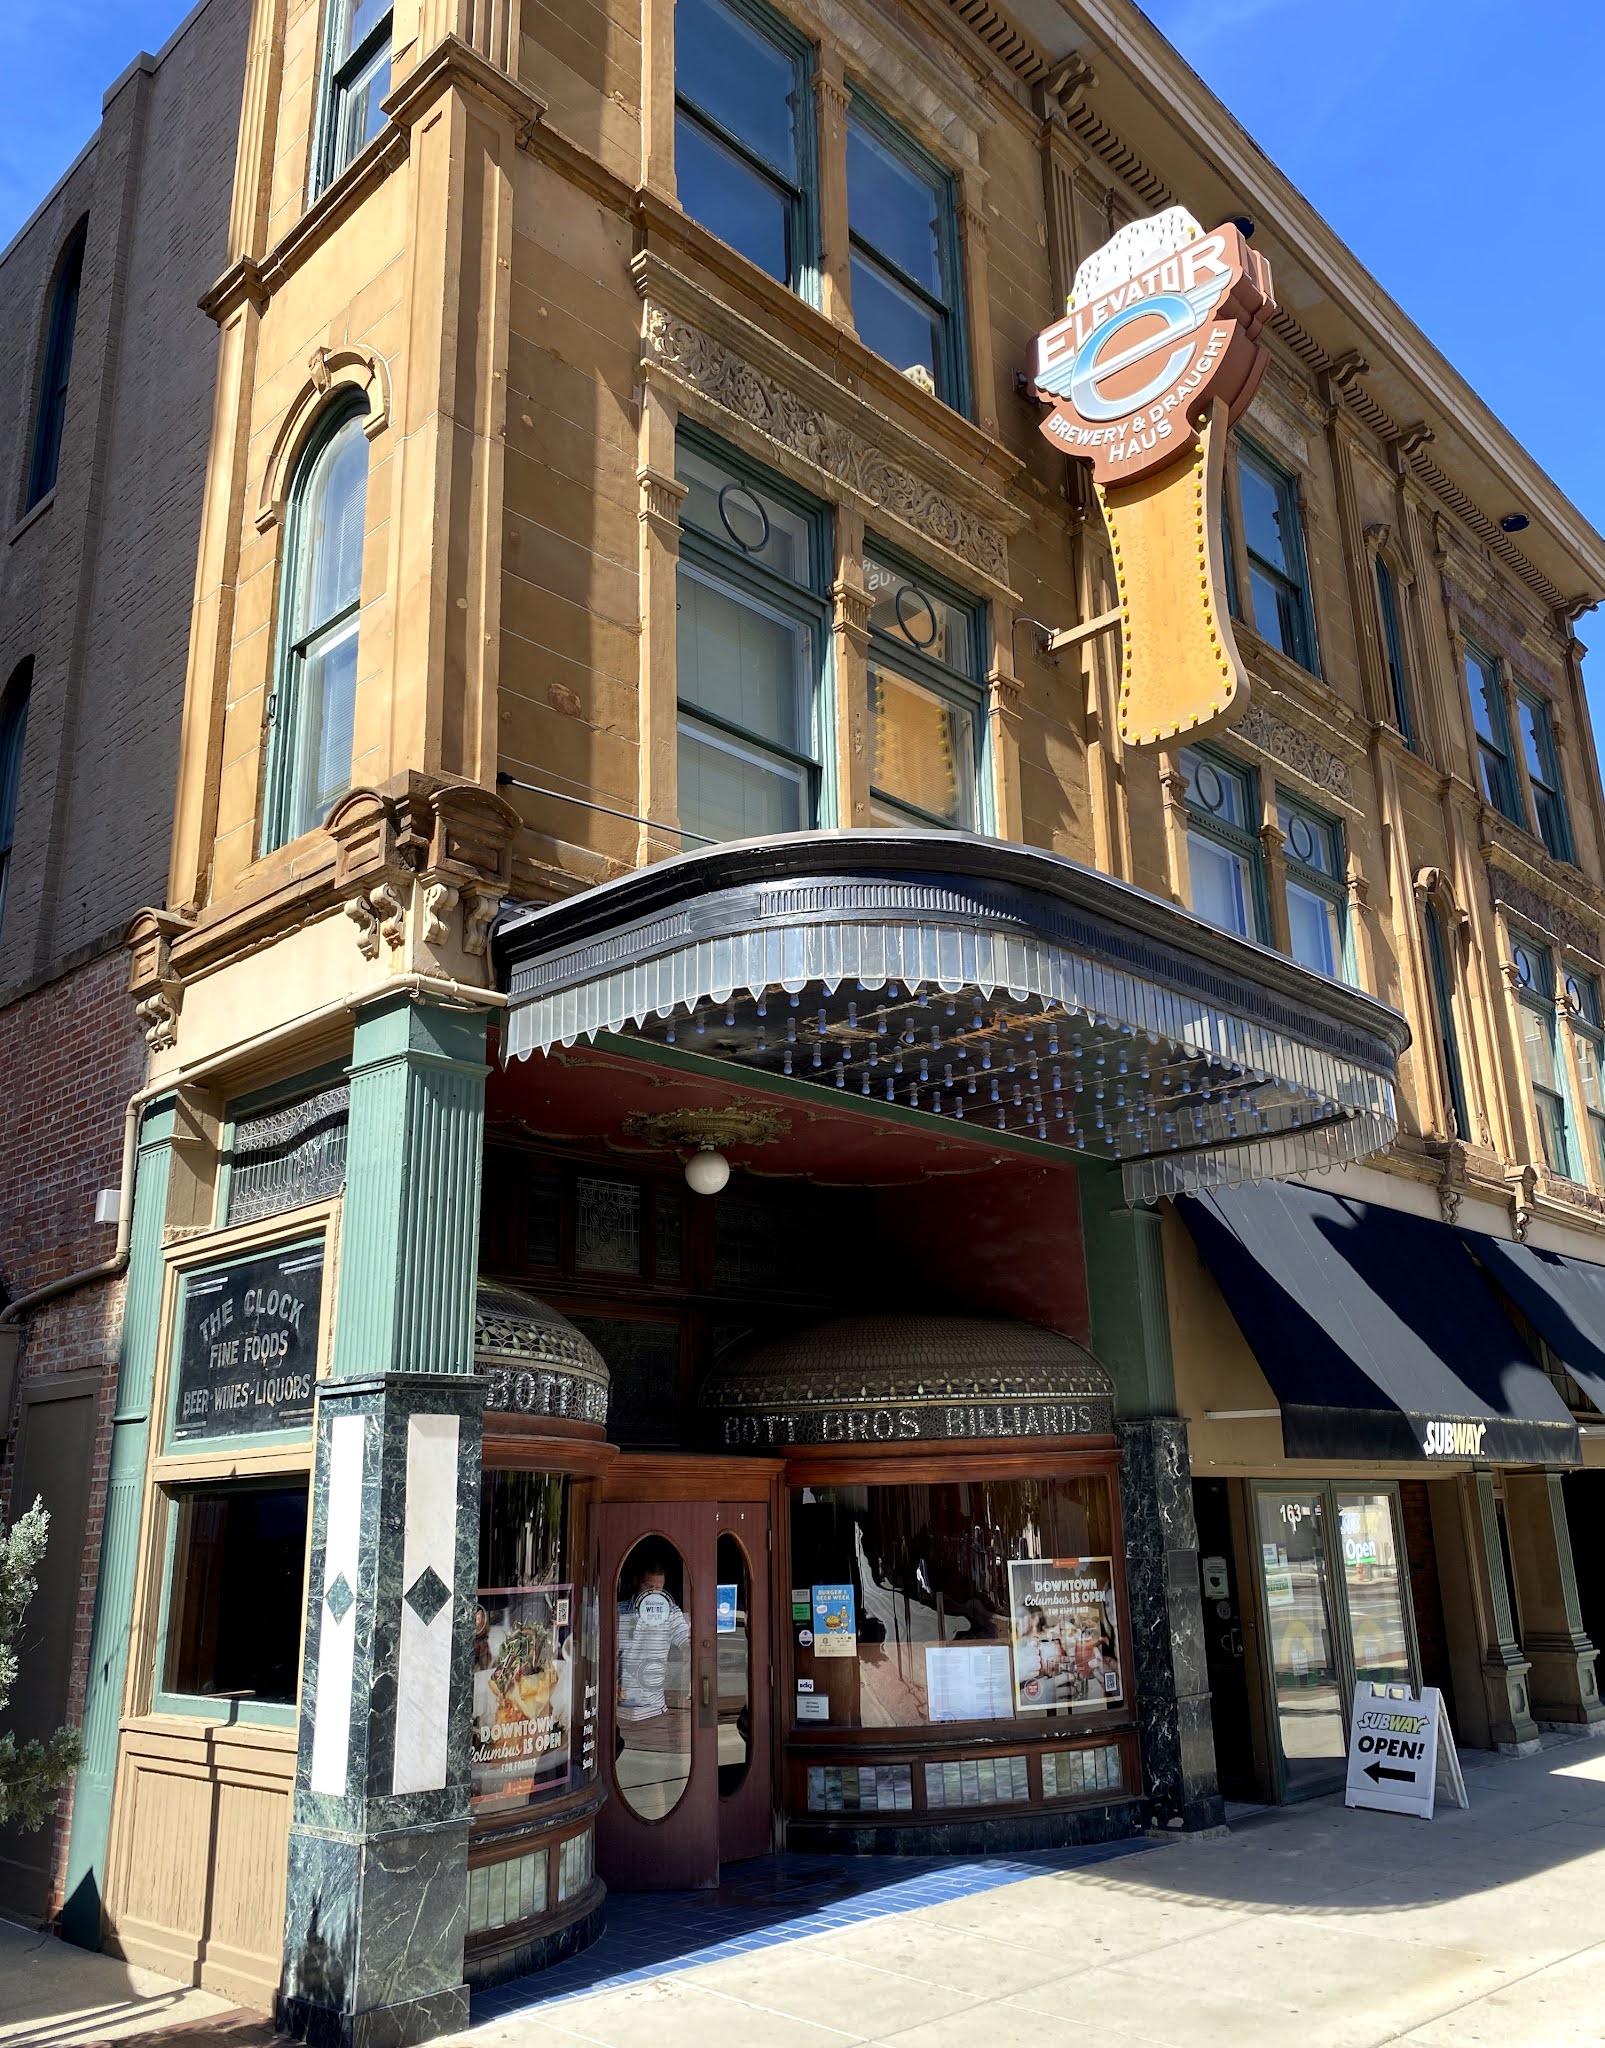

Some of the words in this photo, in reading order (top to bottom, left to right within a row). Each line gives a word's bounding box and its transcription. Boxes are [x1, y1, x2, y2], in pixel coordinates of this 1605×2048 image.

[1037, 234, 1229, 375] ELEVATOR
[1047, 413, 1129, 446] BREWERY
[1132, 417, 1146, 432] &
[1149, 328, 1227, 423] DRAUGHT
[1109, 419, 1173, 463] HAUS
[200, 1298, 234, 1342] THE
[244, 1289, 304, 1331] CLOCK
[209, 1340, 239, 1369] FINE
[243, 1330, 289, 1362] FOODS
[823, 1410, 920, 1440] BROS
[946, 1406, 1092, 1436] BILLIARDS
[1423, 1421, 1486, 1456] SUBWAY
[1346, 1539, 1376, 1563] Open
[1024, 1592, 1070, 1607] Columbus
[1071, 1592, 1081, 1604] IS
[1082, 1591, 1106, 1603] OPEN
[1034, 1579, 1097, 1592] DOWNTOWN
[480, 1716, 554, 1743] DOWNTOWN
[1357, 1712, 1430, 1734] SUBWAY
[523, 1737, 534, 1755] IS
[535, 1731, 562, 1752] OPEN
[1358, 1735, 1425, 1761] OPEN!
